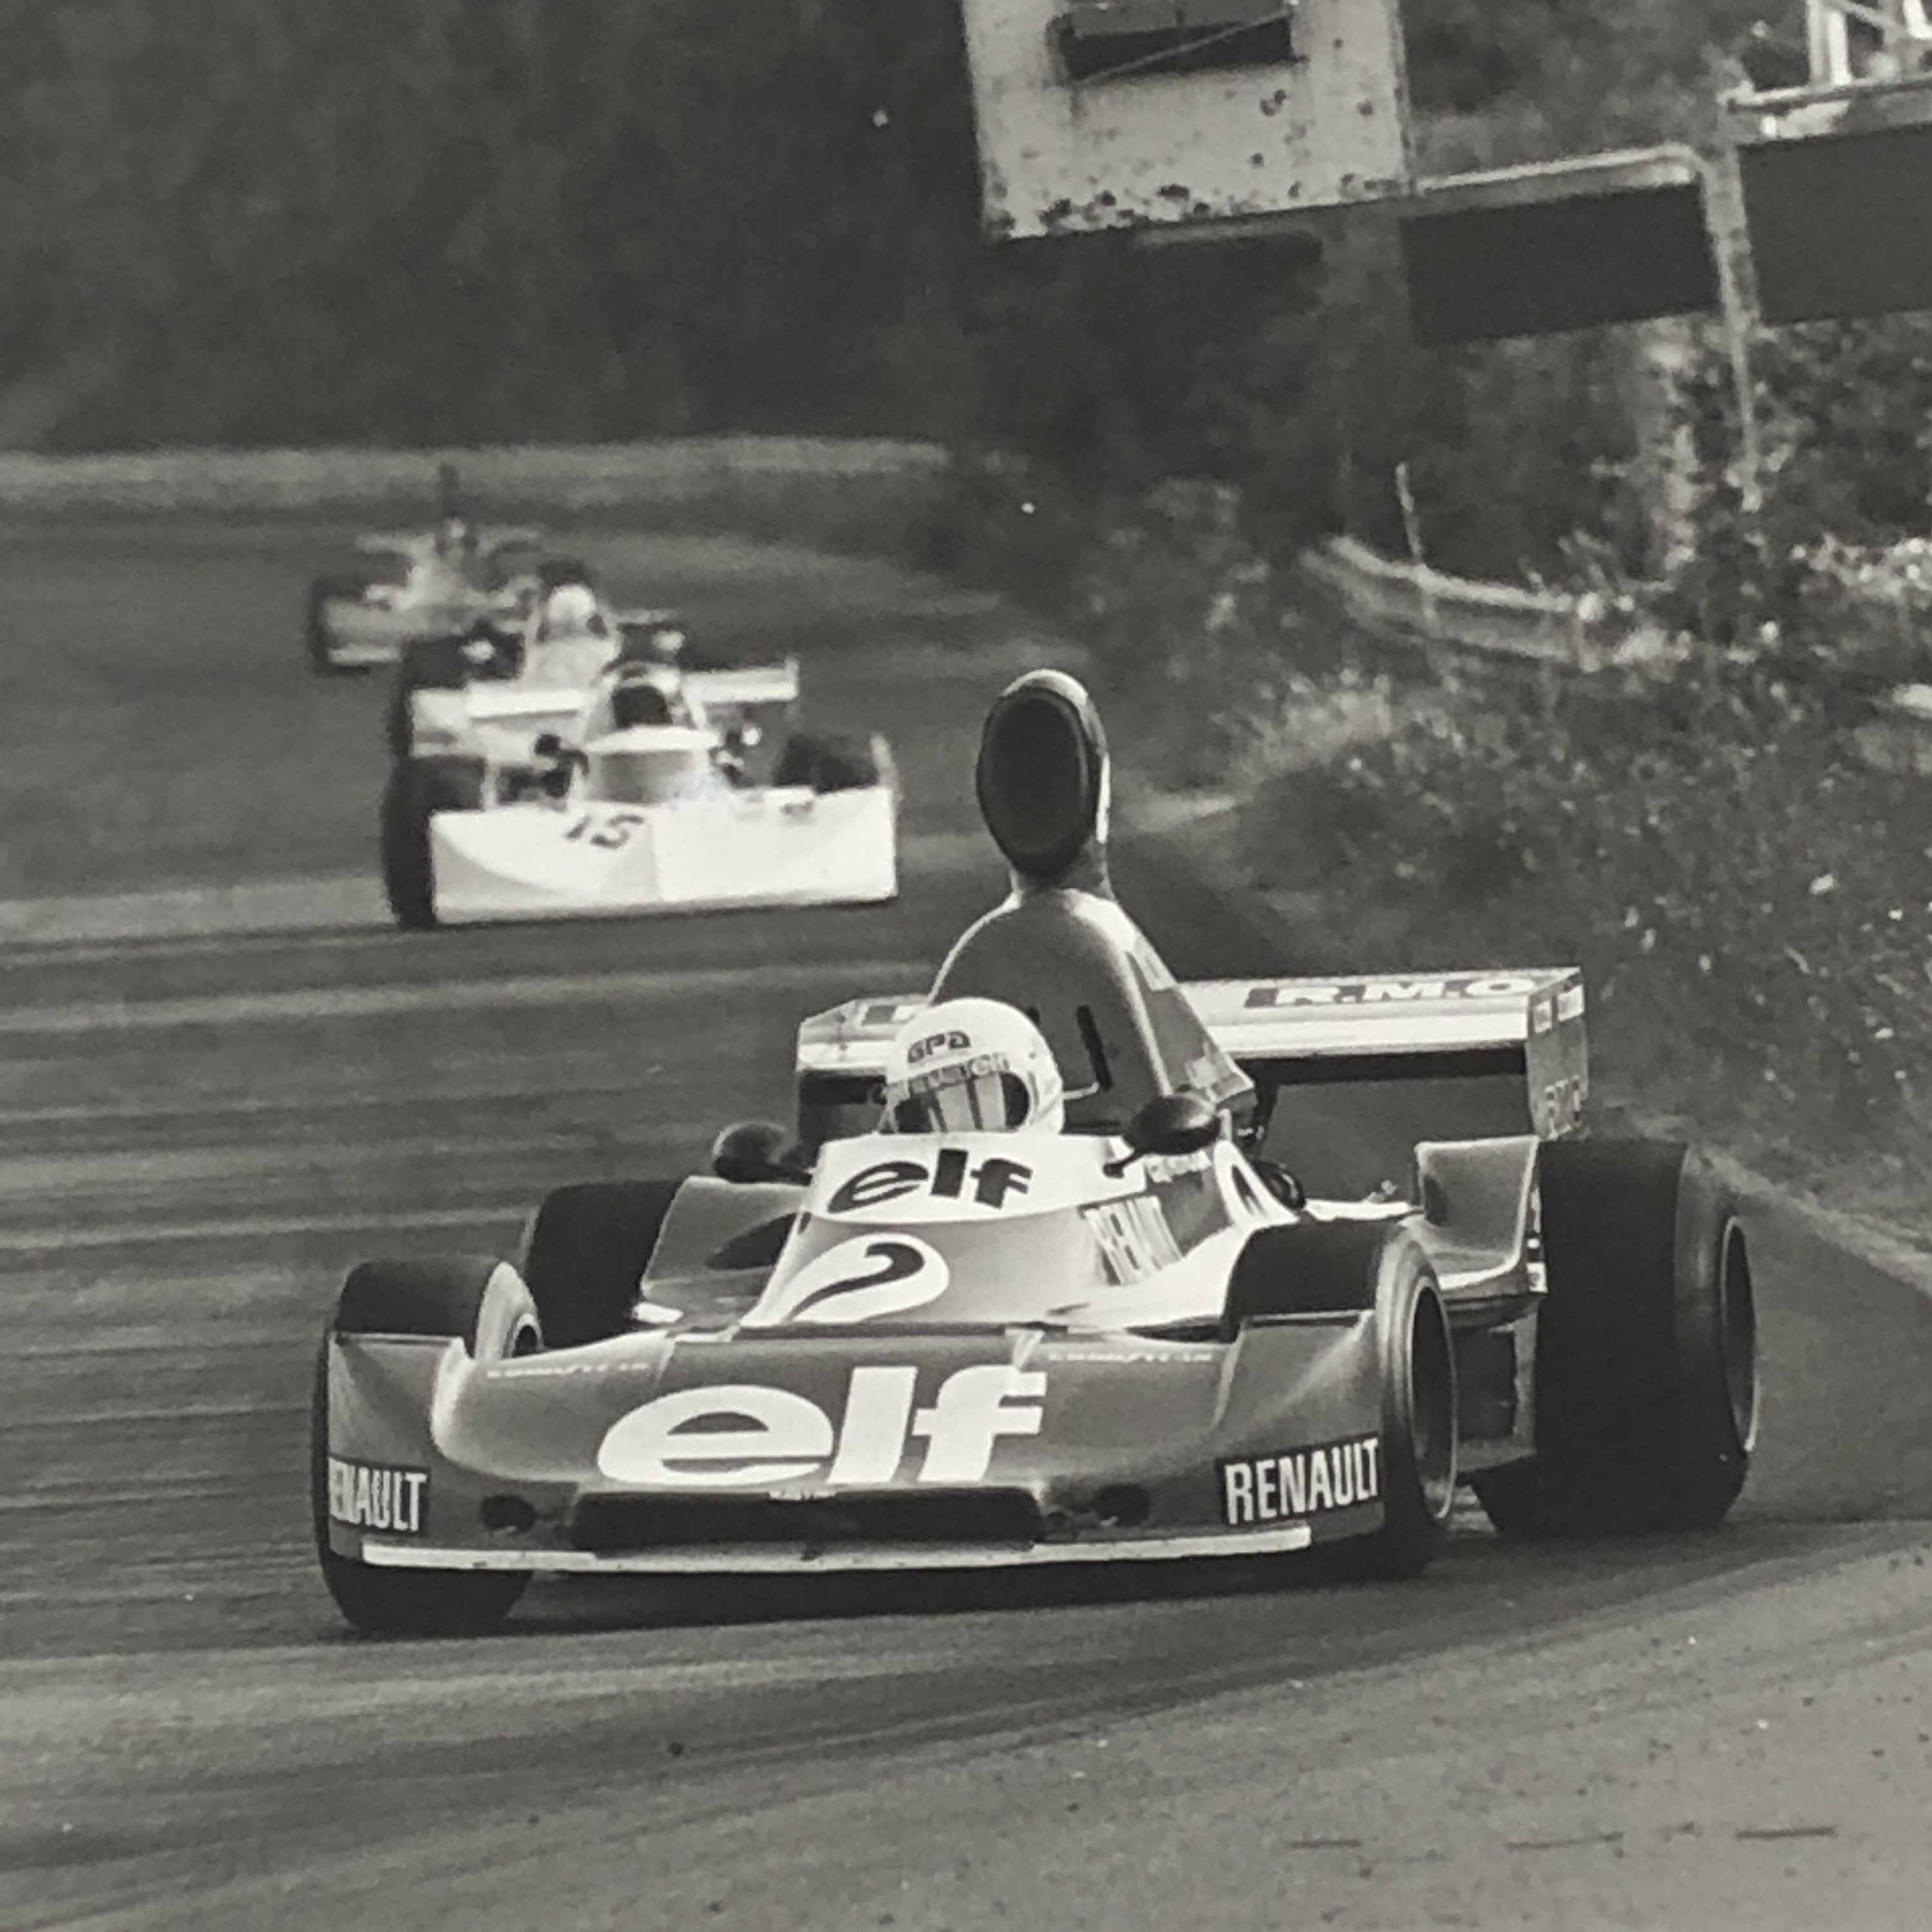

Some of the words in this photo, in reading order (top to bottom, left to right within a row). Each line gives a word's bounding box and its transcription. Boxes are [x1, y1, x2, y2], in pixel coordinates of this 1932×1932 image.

[562, 813, 645, 849] 15
[828, 1148, 1033, 1210] elf
[786, 1242, 925, 1322] 2
[597, 1365, 1048, 1486] elf
[328, 1457, 428, 1531] ENAULT
[1224, 1437, 1379, 1526] RENAULT
